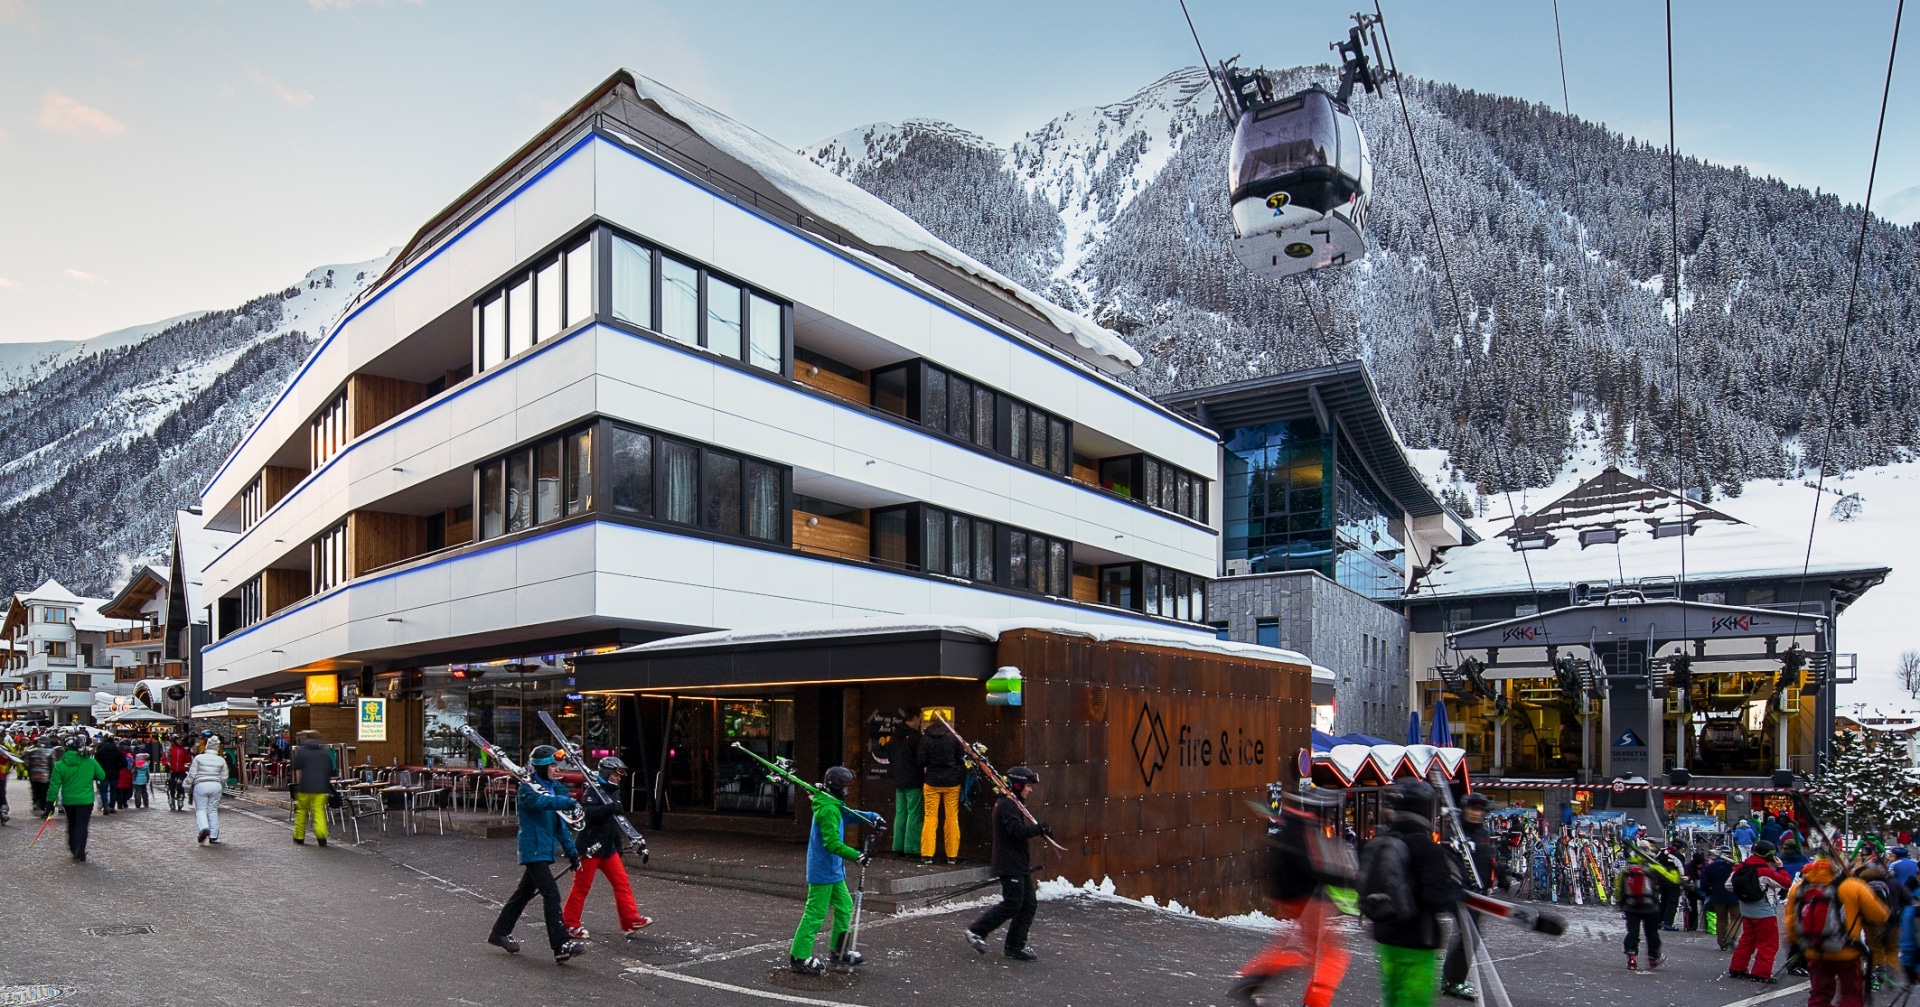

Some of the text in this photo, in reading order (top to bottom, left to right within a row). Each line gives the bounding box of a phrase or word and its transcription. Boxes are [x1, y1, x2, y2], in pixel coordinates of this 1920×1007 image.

[1270, 194, 1285, 208] 57
[1179, 725, 1264, 767] fire & ice
